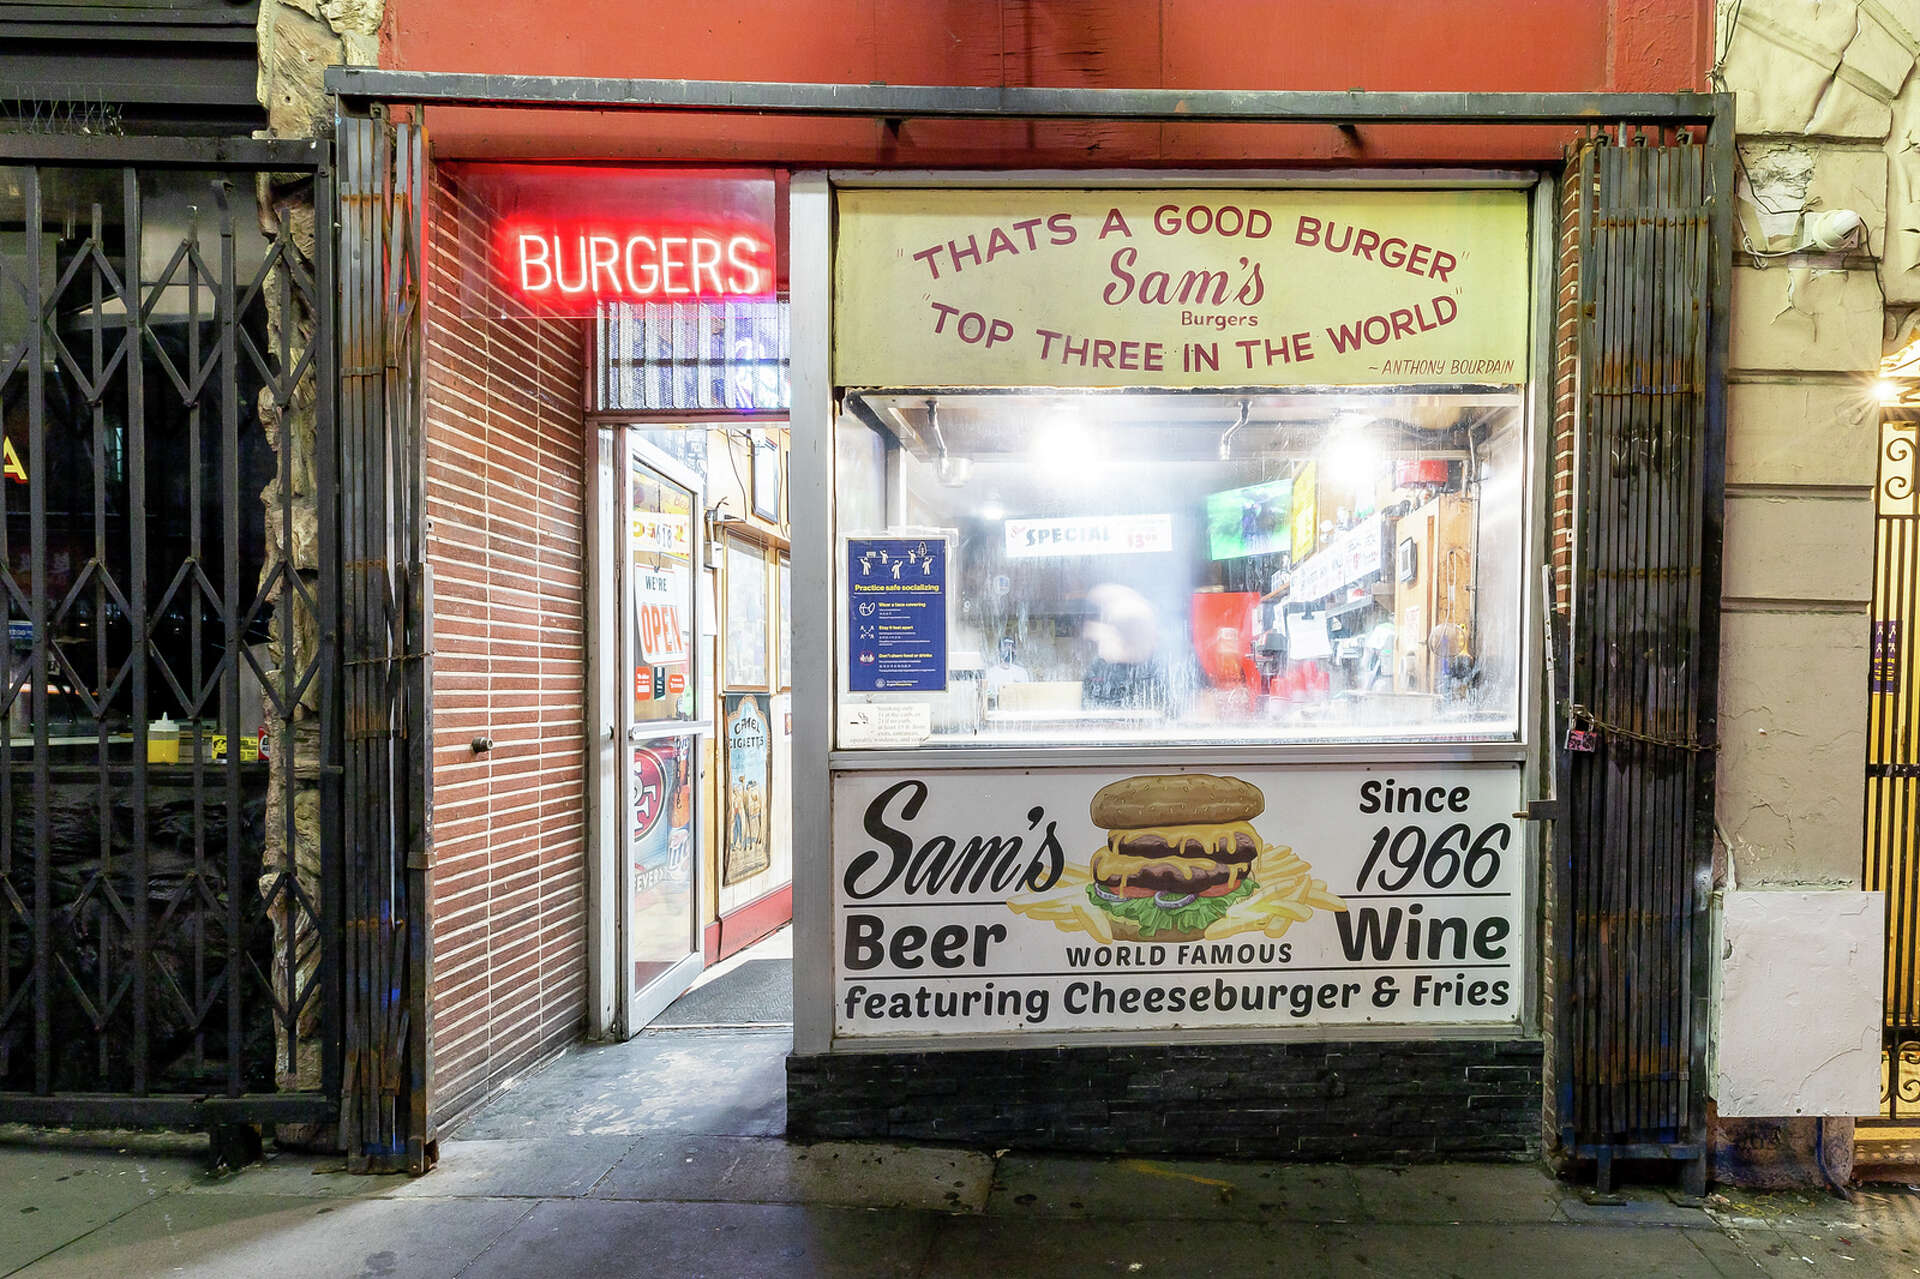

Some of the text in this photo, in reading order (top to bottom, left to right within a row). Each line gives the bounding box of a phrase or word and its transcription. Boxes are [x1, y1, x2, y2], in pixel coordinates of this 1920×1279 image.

[1099, 207, 1132, 239] A
[1153, 204, 1273, 239] GOOD
[519, 233, 761, 295] BURGERS
[1102, 246, 1266, 306] Sam's
[1180, 311, 1259, 331] Burgers
[1035, 328, 1165, 373] THREE
[1182, 342, 1220, 373] IN
[1239, 333, 1314, 369] THE
[1381, 359, 1515, 375] ANTHONY BOURDAIN
[1024, 526, 1112, 547] SPECIAL
[645, 575, 668, 592] WE'RE
[854, 584, 940, 593] Practice safe socializing
[640, 603, 684, 655] OPEN
[1359, 779, 1470, 814] Since
[843, 779, 1066, 899] Sam's
[1356, 822, 1511, 892] 1966
[844, 914, 1007, 971] Beer
[1066, 942, 1293, 969] WORLD FAMOUS
[1335, 903, 1511, 963] Wine
[844, 973, 1511, 1025] featuring Cheeseburger & Fries
